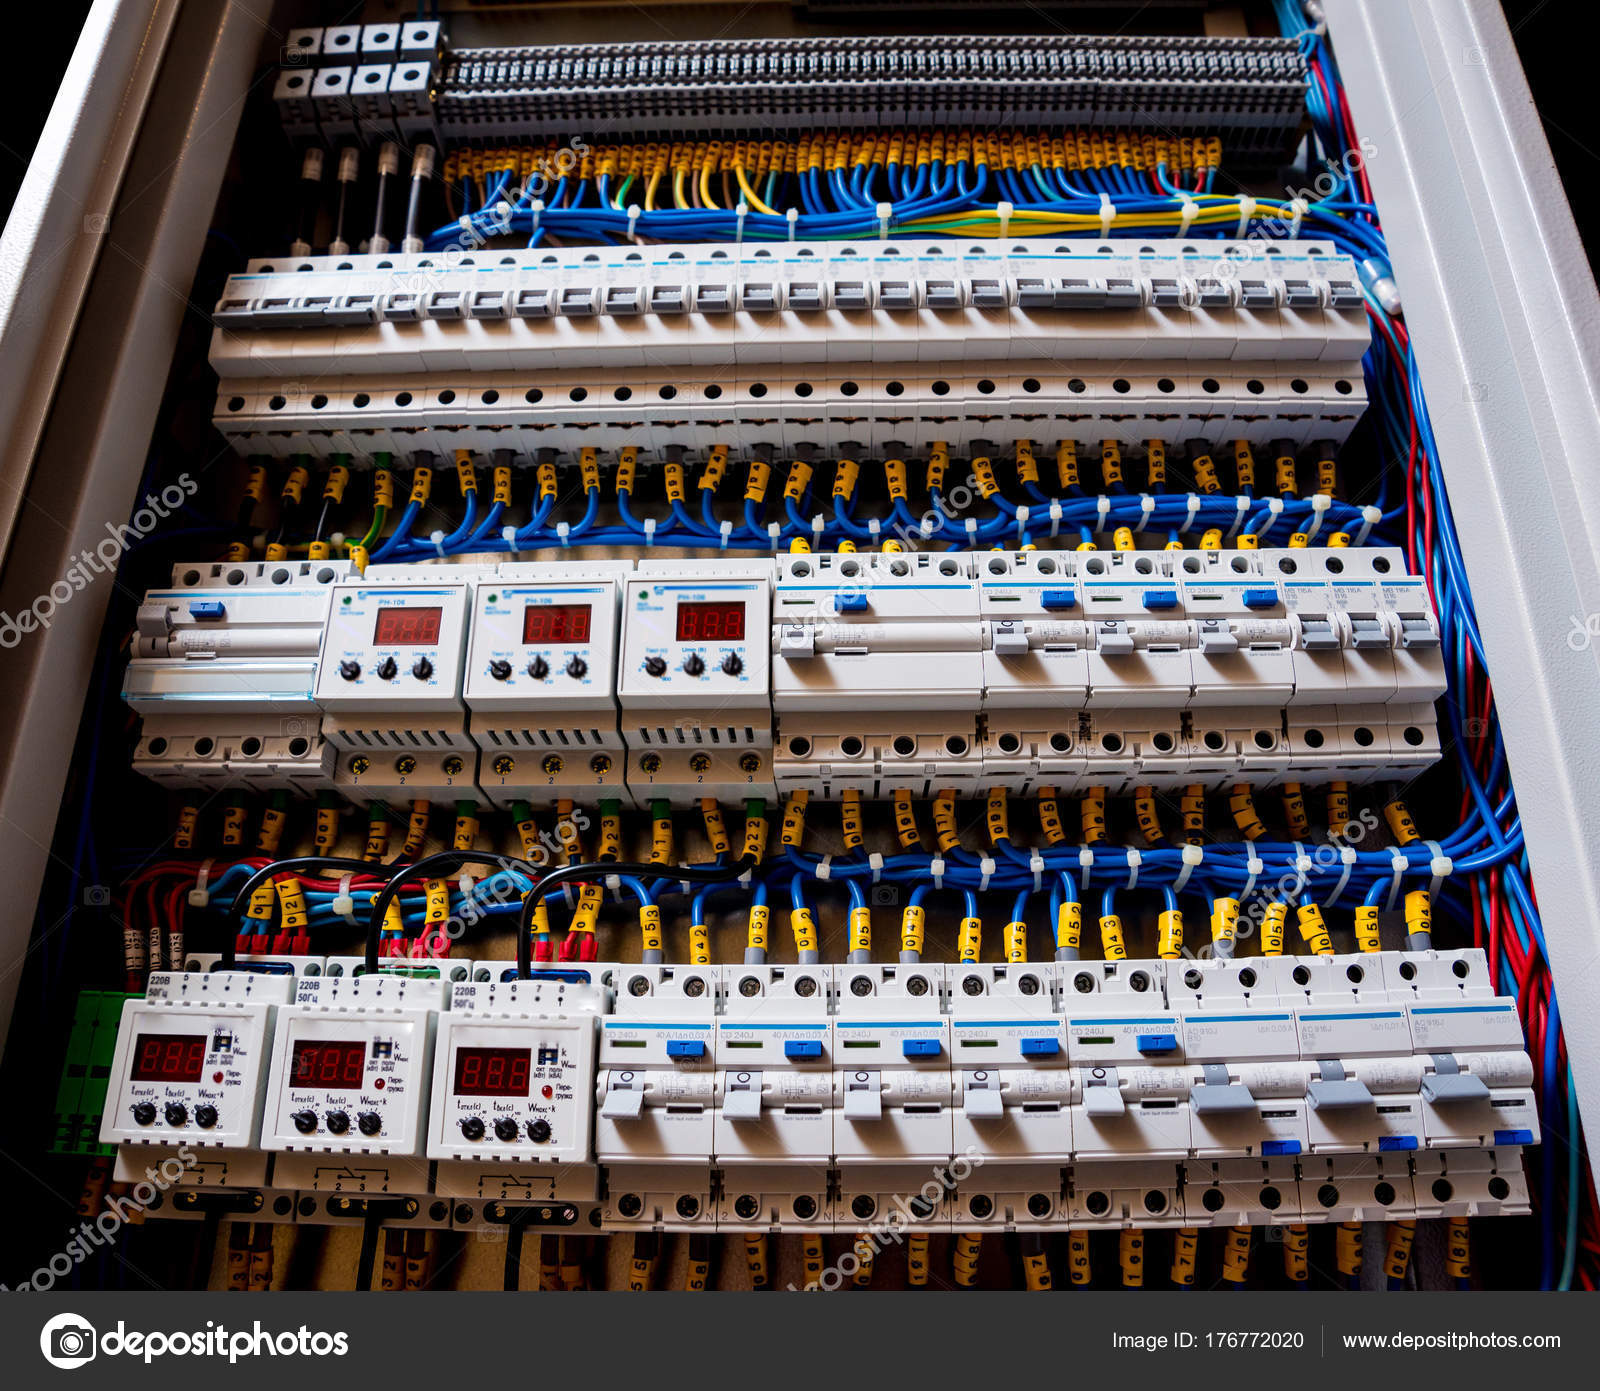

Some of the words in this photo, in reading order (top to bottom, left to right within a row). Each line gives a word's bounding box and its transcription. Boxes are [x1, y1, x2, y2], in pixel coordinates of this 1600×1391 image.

[280, 884, 297, 924] 027
[577, 888, 597, 928] 025
[645, 910, 659, 946] 053
[753, 911, 767, 943] 053
[800, 912, 811, 946] 042
[859, 911, 869, 946] 051
[906, 909, 919, 947] 042
[1011, 925, 1026, 958] 045
[1068, 906, 1081, 944] 052
[1104, 919, 1124, 954] 043
[1271, 908, 1284, 946] 051
[1368, 911, 1379, 947] 050
[696, 930, 707, 963] 042
